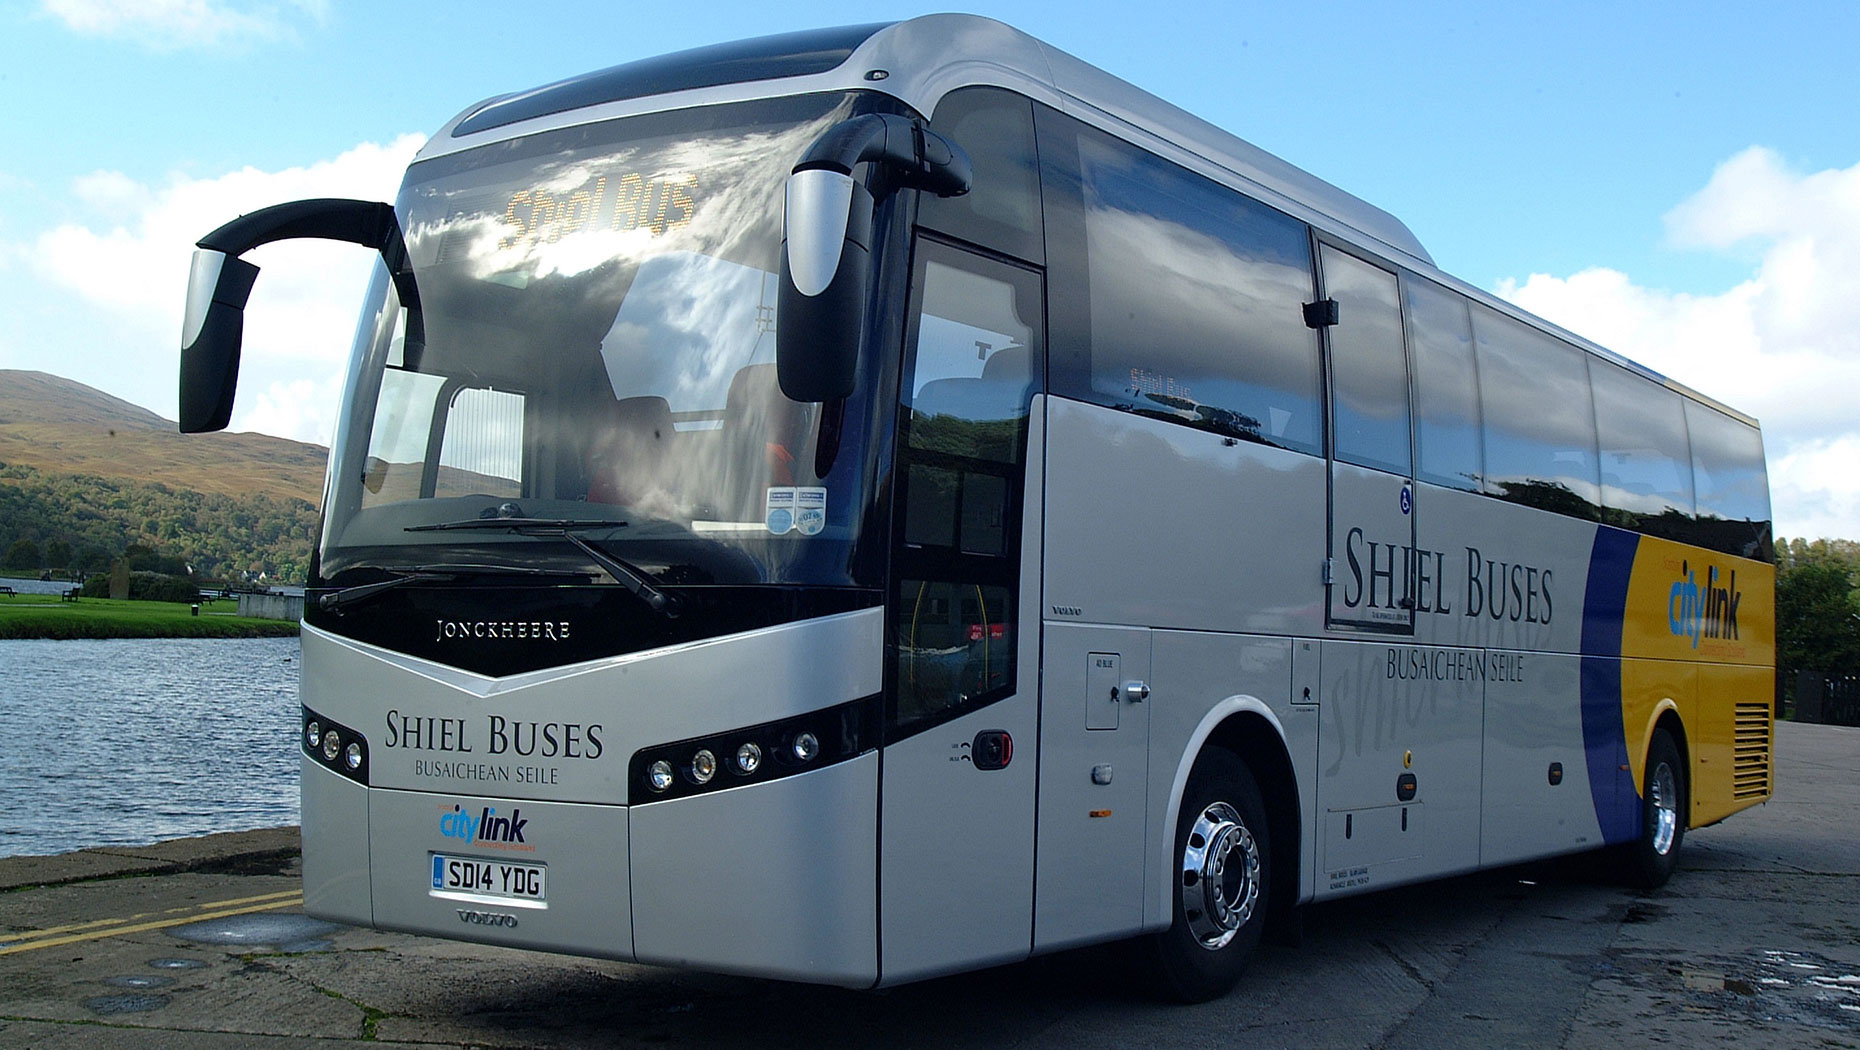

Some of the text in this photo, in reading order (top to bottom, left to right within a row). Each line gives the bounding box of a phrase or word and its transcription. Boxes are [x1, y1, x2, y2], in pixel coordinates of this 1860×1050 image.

[1344, 526, 1553, 625] SHIEL BUSES
[1052, 605, 1082, 616] VOLVO
[1668, 559, 1741, 650] citylink
[436, 619, 571, 642] JONCKHEERE
[1387, 648, 1524, 682] BUSAICHEAN SEILE
[385, 709, 604, 760] SHIEL BUSES
[415, 759, 559, 785] BUSAICHEAN SEILE
[440, 804, 529, 844] citylink
[449, 861, 540, 895] SD14 YDG
[456, 908, 519, 929] VOLVO
